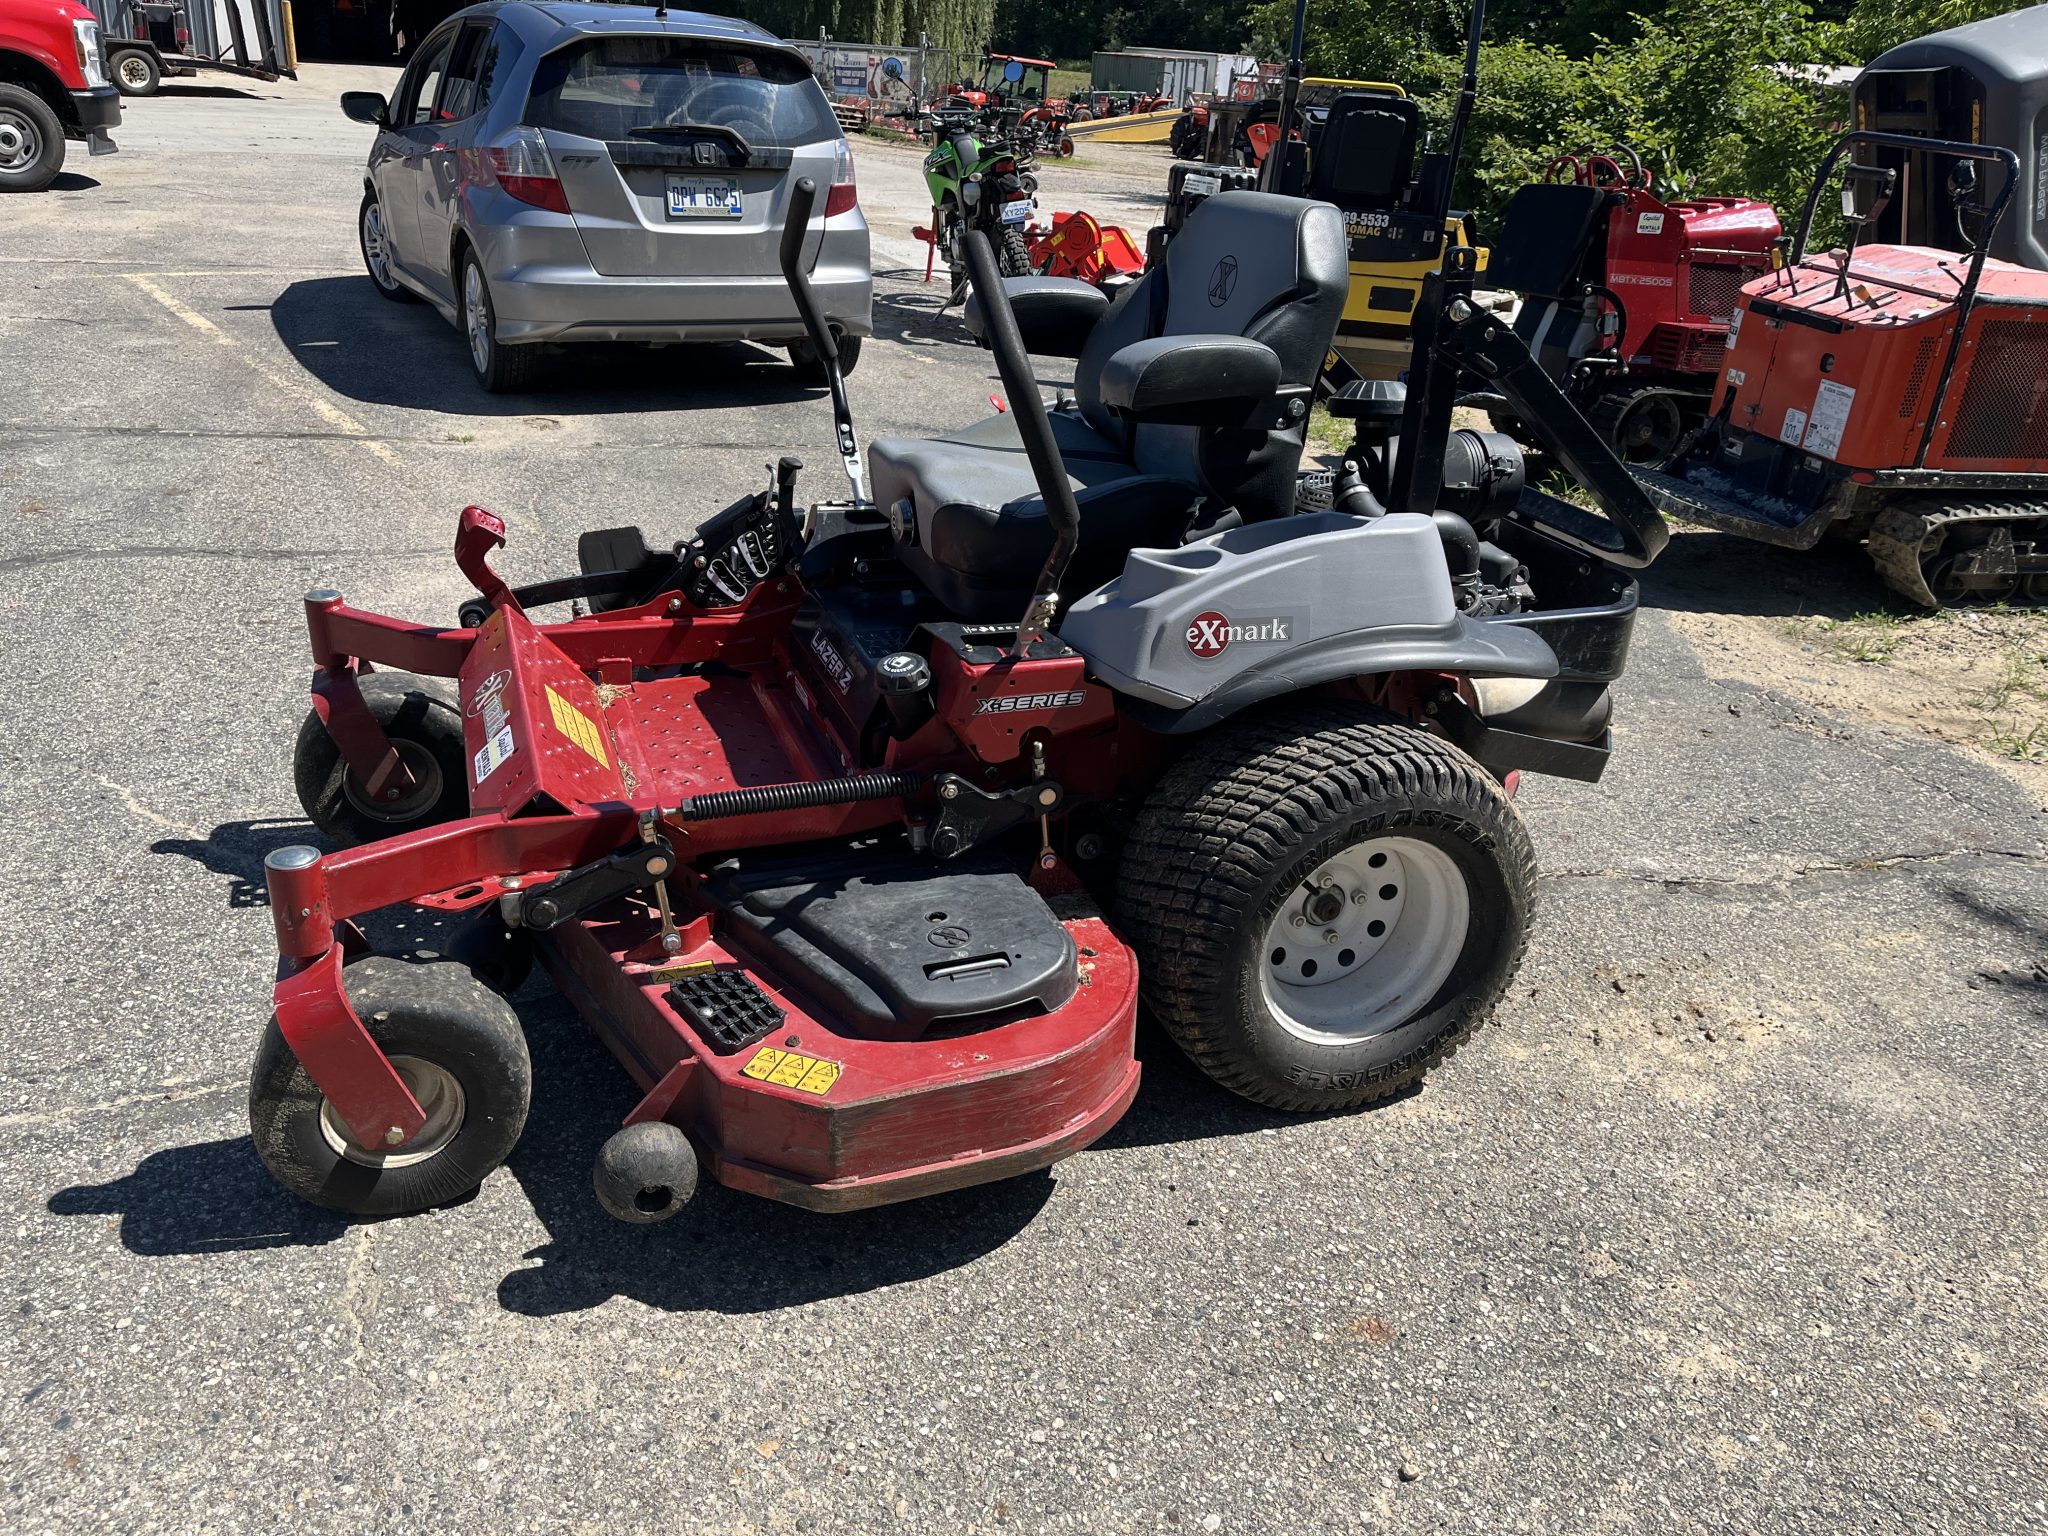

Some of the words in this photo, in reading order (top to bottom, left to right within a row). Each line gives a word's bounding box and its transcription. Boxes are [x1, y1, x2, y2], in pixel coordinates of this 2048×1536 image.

[2040, 135, 2048, 166] MUD
[672, 187, 697, 207] DPW
[706, 187, 738, 208] 6625
[2038, 169, 2047, 217] BUGGY
[1185, 618, 1289, 650] eXmark
[812, 631, 843, 674] LAZER
[976, 692, 1086, 713] X-SERIES
[497, 730, 511, 757] Capital
[480, 747, 492, 776] RENTALS
[1257, 831, 1340, 918] TURF
[1350, 808, 1496, 853] MASTER
[1284, 1018, 1460, 1091] CARLISLE
